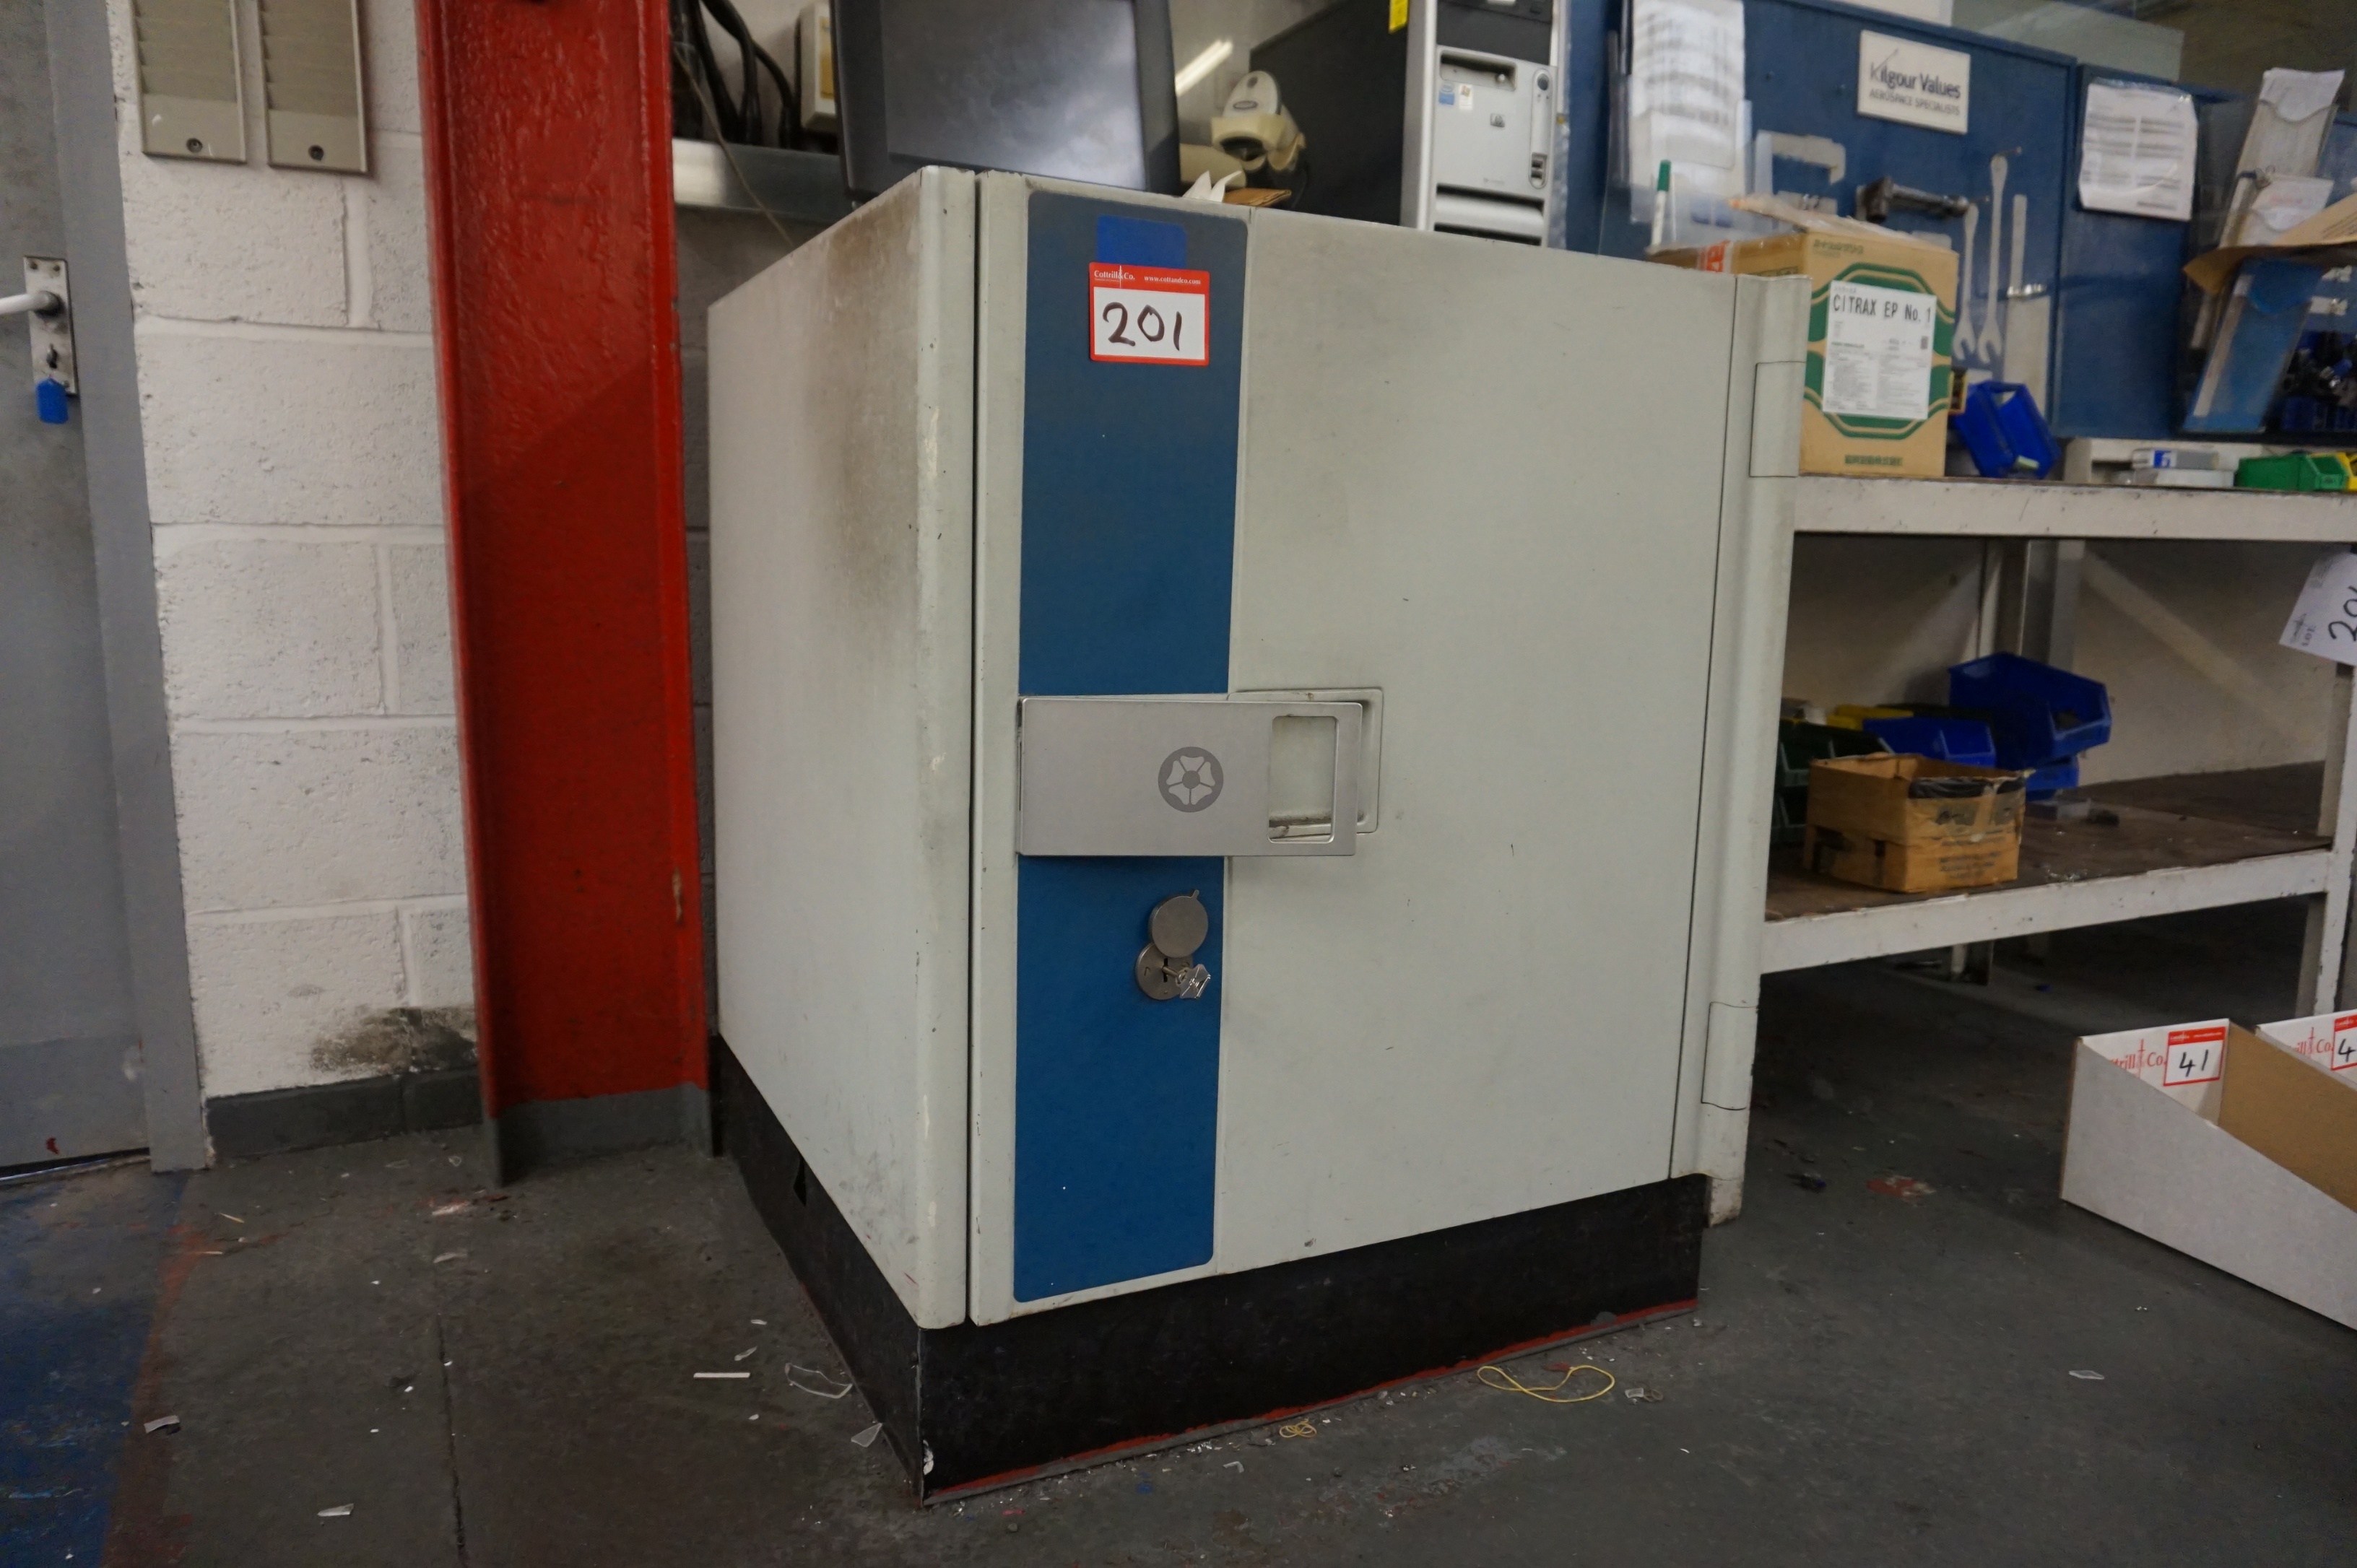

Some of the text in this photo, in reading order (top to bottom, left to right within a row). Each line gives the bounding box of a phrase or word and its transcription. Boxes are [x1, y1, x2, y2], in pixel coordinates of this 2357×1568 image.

[1870, 48, 1961, 99] Kilgour Values
[1144, 275, 1201, 284] www.cottandco.com
[1102, 302, 1182, 352] 201
[1833, 294, 1931, 323] CITRAX EP No. 1
[2328, 585, 2357, 642] 20
[2179, 1049, 2209, 1077] 41
